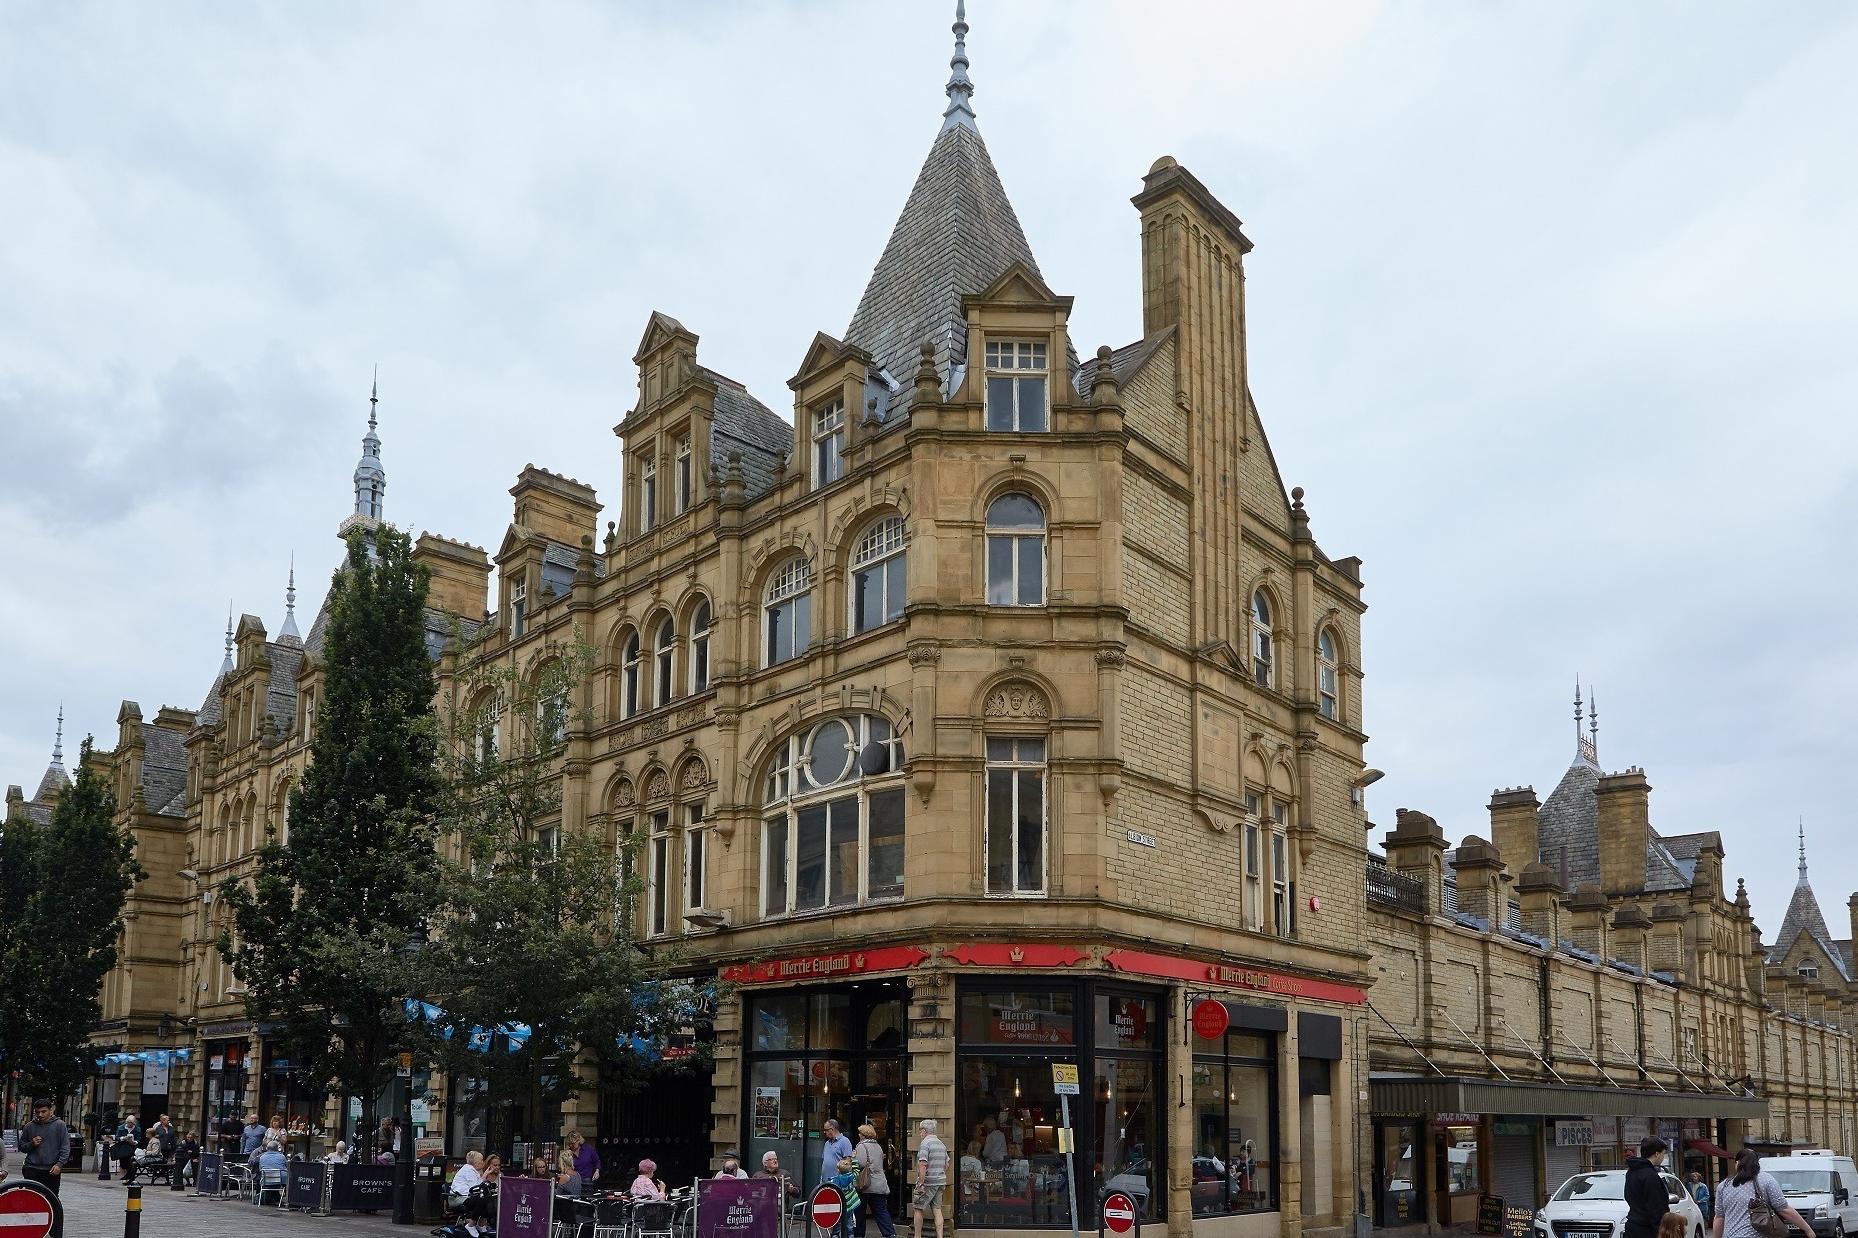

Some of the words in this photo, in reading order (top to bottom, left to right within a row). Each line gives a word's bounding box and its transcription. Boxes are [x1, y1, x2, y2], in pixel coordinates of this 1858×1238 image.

[782, 961, 810, 975] Merrie
[813, 955, 849, 974] England
[1221, 966, 1244, 983] Merrie
[1246, 971, 1271, 989] England
[1001, 1010, 1034, 1021] Merrie
[1115, 1014, 1134, 1025] Merrie
[1200, 1012, 1221, 1020] Merrie
[999, 1021, 1036, 1033] England
[1114, 1026, 1135, 1037] England
[1562, 1127, 1593, 1145] PISCES
[353, 1179, 393, 1187] BROWN'S
[361, 1187, 383, 1195] CAFE
[729, 1206, 751, 1215] Merrie
[1507, 1207, 1533, 1216] Mello's
[727, 1215, 753, 1225] England
[1507, 1213, 1533, 1221] BARBERS
